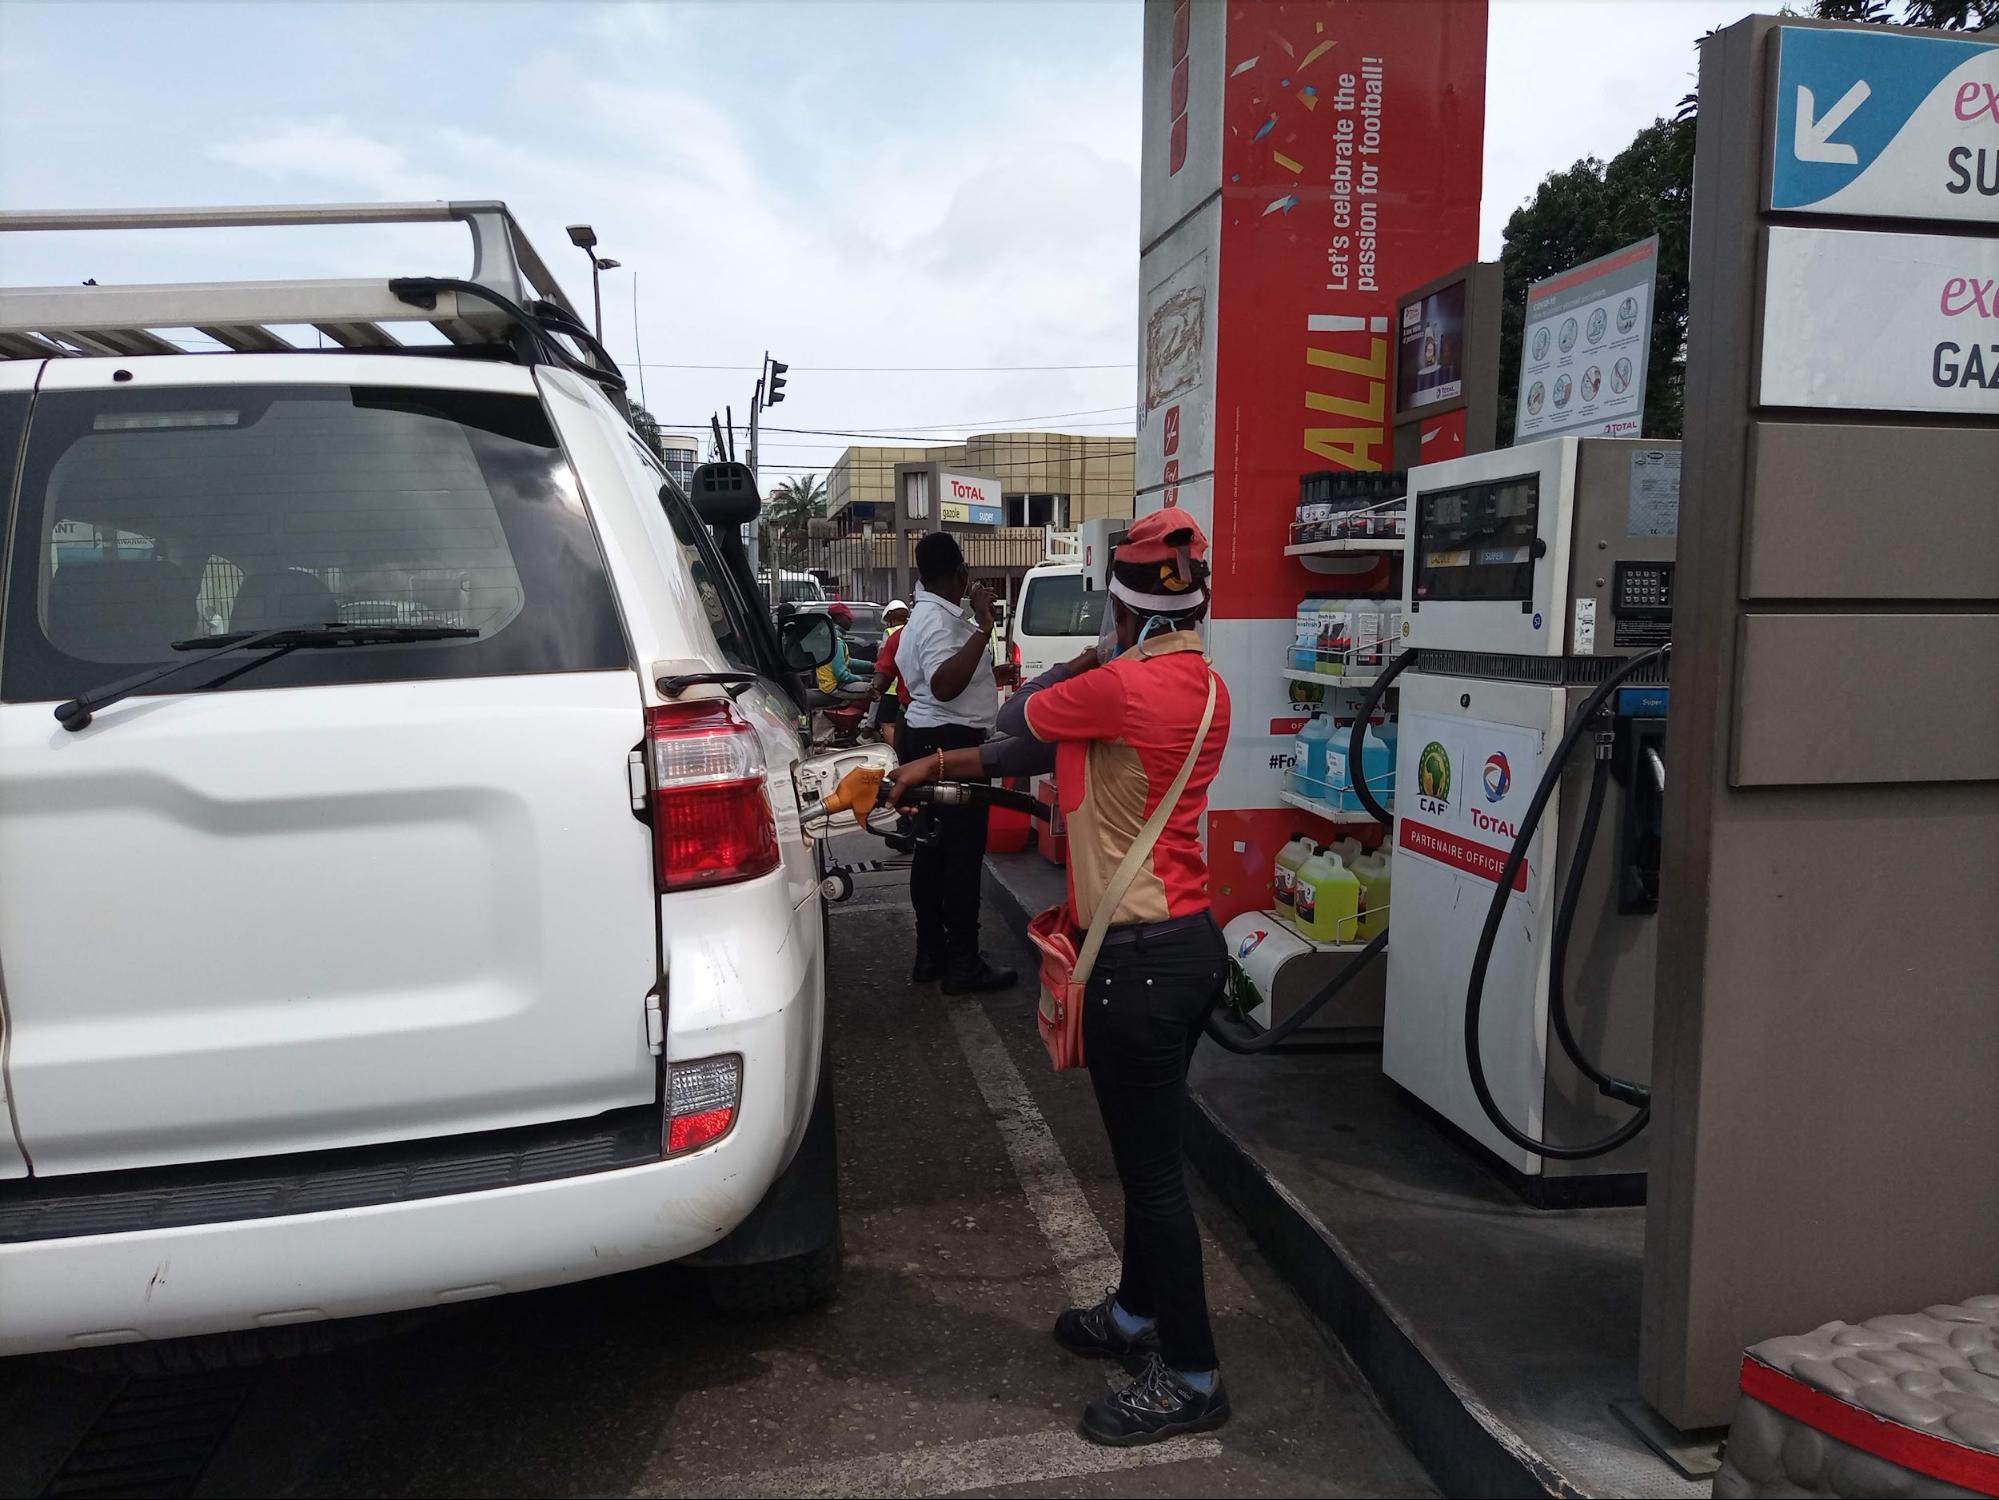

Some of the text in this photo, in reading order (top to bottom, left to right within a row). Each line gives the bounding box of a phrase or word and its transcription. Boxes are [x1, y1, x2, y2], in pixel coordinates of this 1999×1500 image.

[1333, 72, 1356, 112] the
[1329, 118, 1354, 229] celebrate
[1354, 56, 1384, 292] passion for football!
[1611, 421, 1638, 432] TOTAL
[951, 480, 985, 501] TOTAL
[942, 507, 960, 520] gazole
[978, 511, 994, 523] super
[1484, 551, 1505, 561] SUPER
[1292, 703, 1321, 712] CAF
[1641, 697, 1662, 707] Super
[1269, 753, 1298, 769] #Fo
[1419, 798, 1446, 816] CAF
[1470, 808, 1519, 840] TOTAL
[1411, 830, 1463, 860] PARTENAIRE
